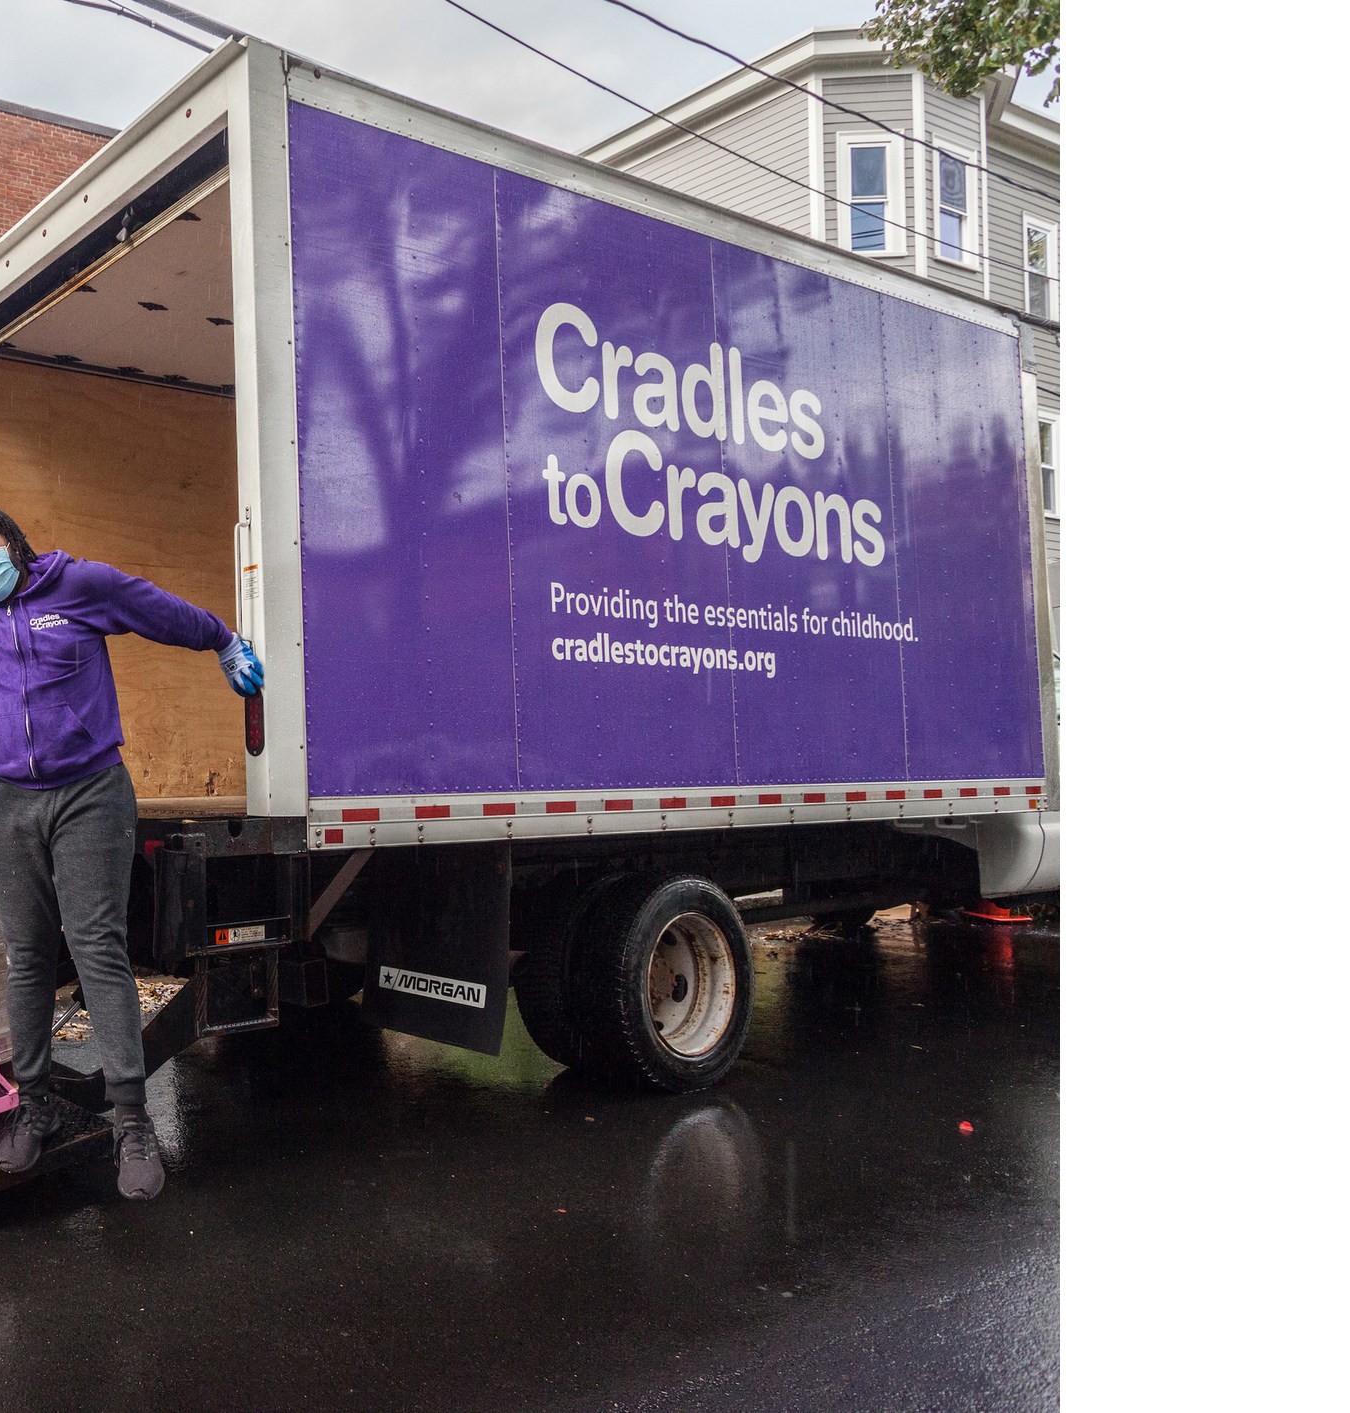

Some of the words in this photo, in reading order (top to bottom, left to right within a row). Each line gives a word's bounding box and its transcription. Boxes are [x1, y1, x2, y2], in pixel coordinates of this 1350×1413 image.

[535, 302, 825, 460] Cradles
[542, 454, 602, 529] to
[605, 430, 886, 567] Crayons
[30, 614, 60, 626] Cradles
[36, 619, 69, 630] Crayons
[551, 581, 658, 629] Providing
[663, 595, 699, 625] the
[705, 603, 798, 633] essentials
[801, 607, 828, 635] for
[832, 611, 919, 642] childhood.
[551, 633, 776, 678] cradlestocrayons.org
[397, 974, 481, 1003] MORGAN
